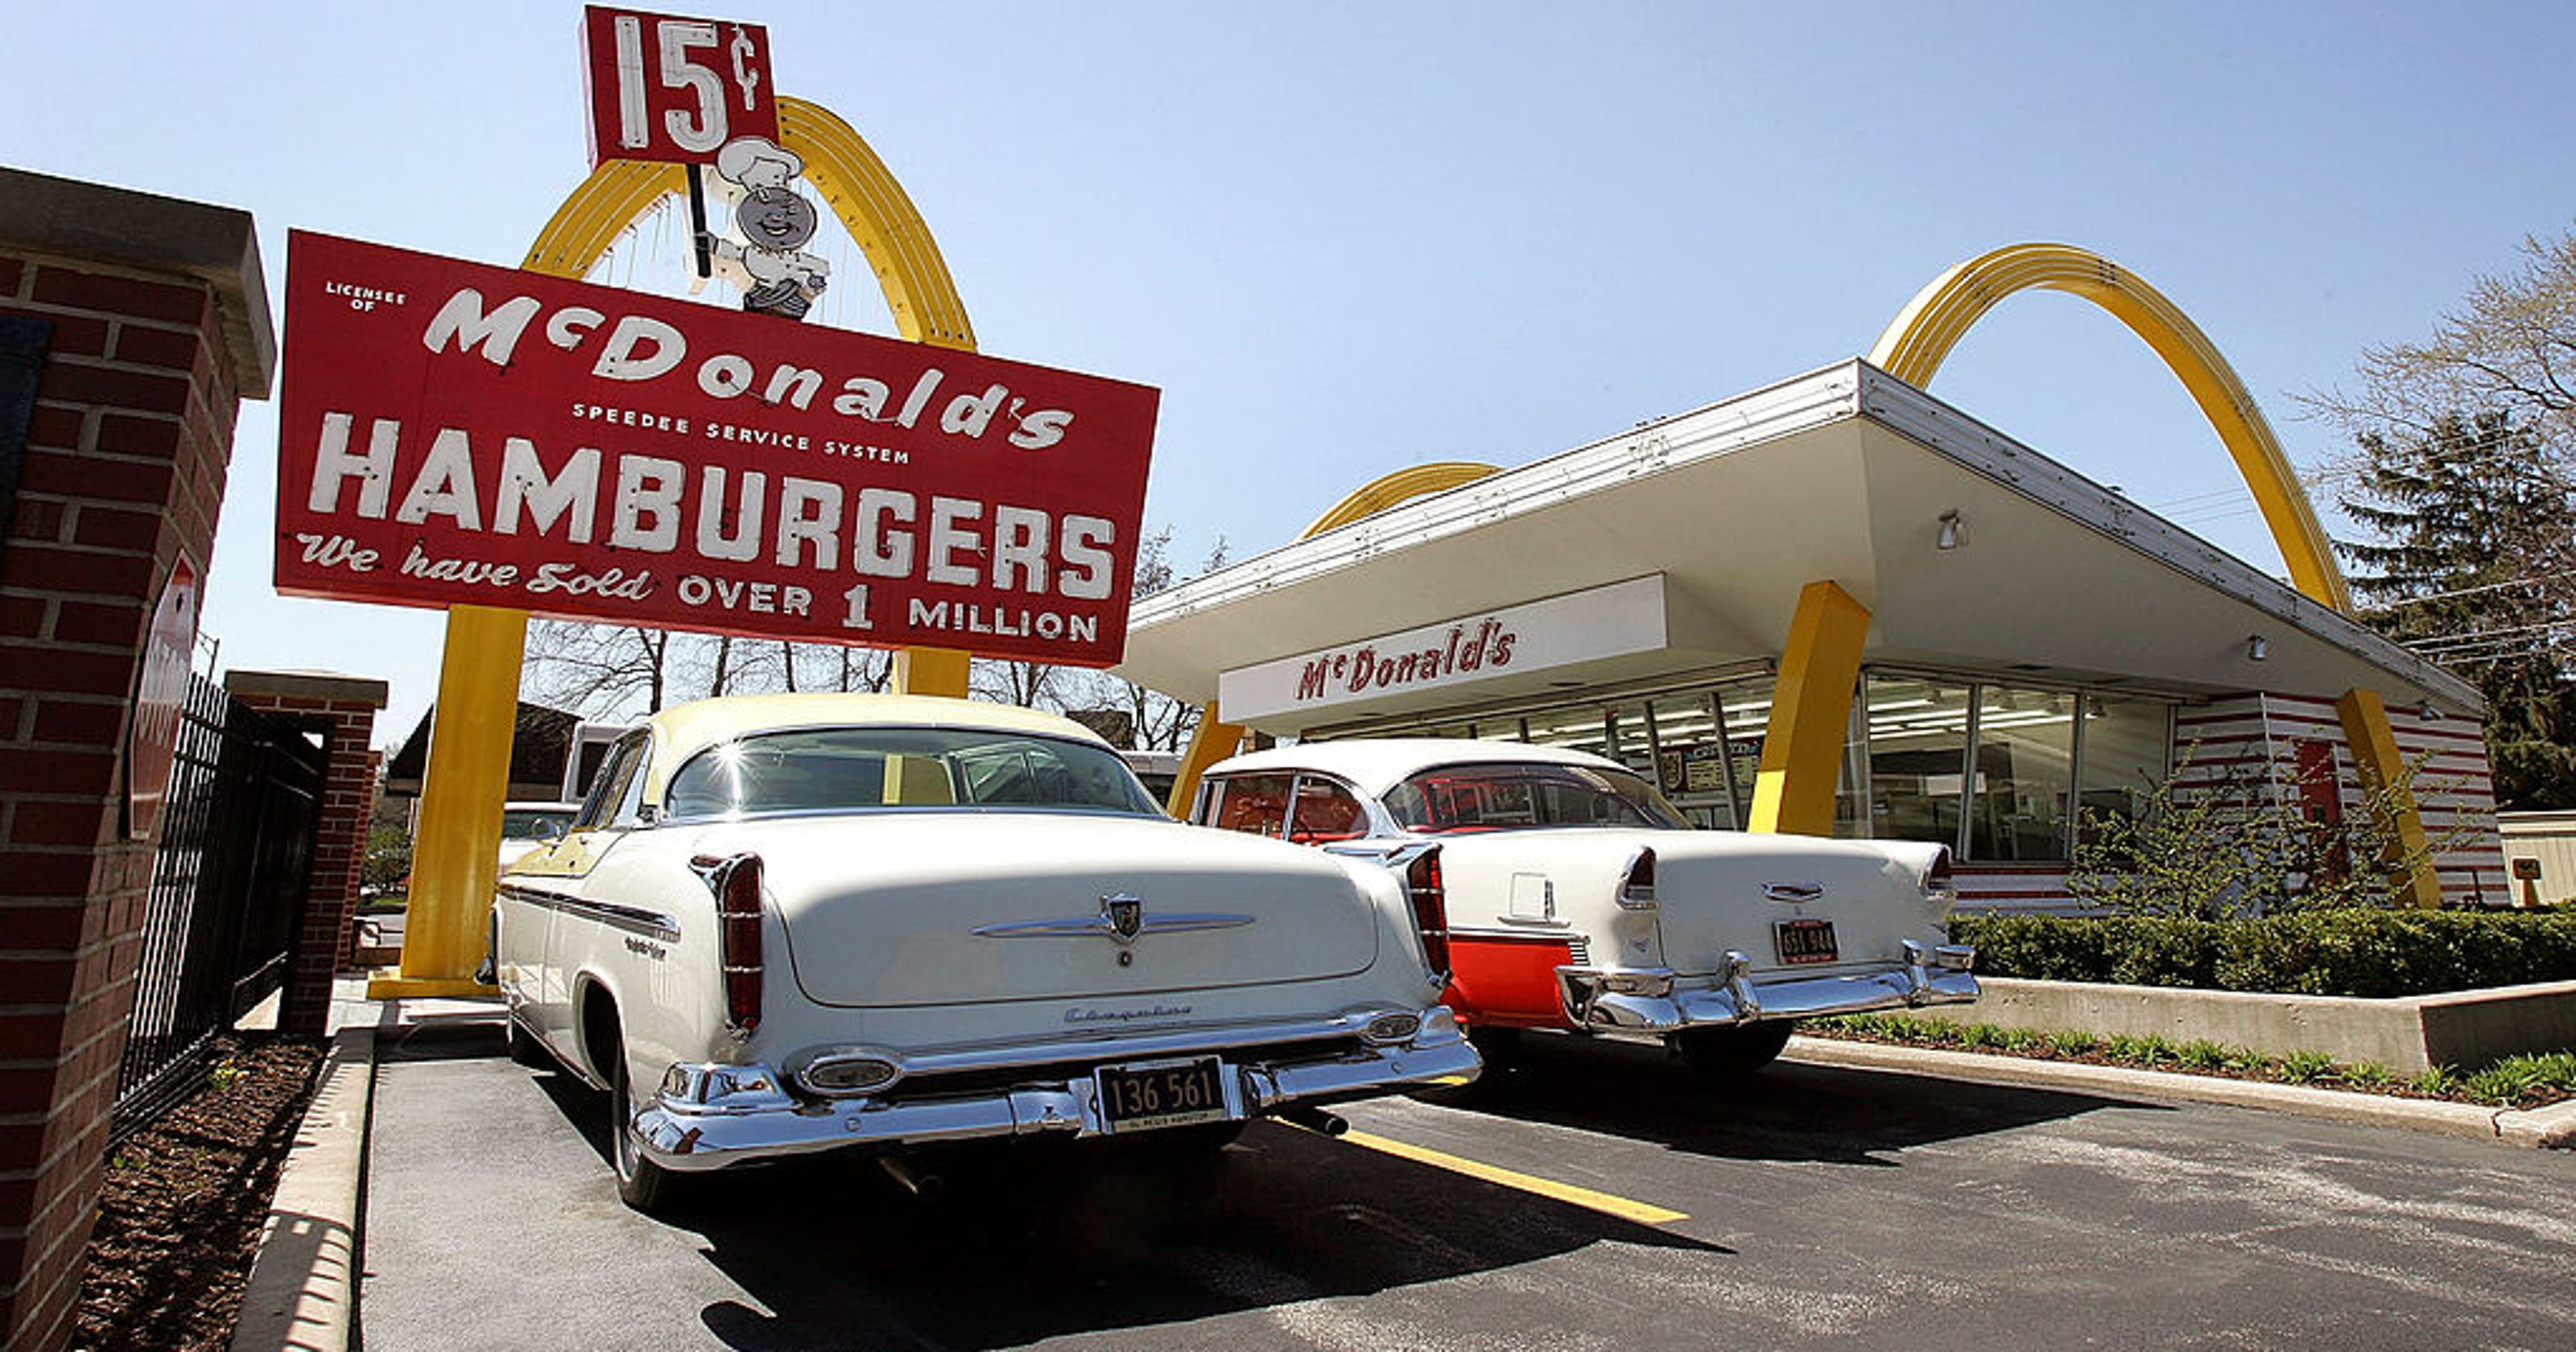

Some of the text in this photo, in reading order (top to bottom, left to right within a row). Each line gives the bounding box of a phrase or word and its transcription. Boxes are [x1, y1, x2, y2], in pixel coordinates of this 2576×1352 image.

[326, 280, 406, 304] LICENSEE
[351, 299, 375, 312] OF
[423, 287, 1075, 449] McDonald's
[572, 404, 910, 464] SPEEDEE SERVICE SYSTEM
[308, 411, 1116, 600] HAMBURGERS
[295, 534, 1097, 643] We have Sold OVER 1 MILLION
[1296, 619, 1516, 700] McDonald's
[1111, 1070, 1212, 1115] 136 561
